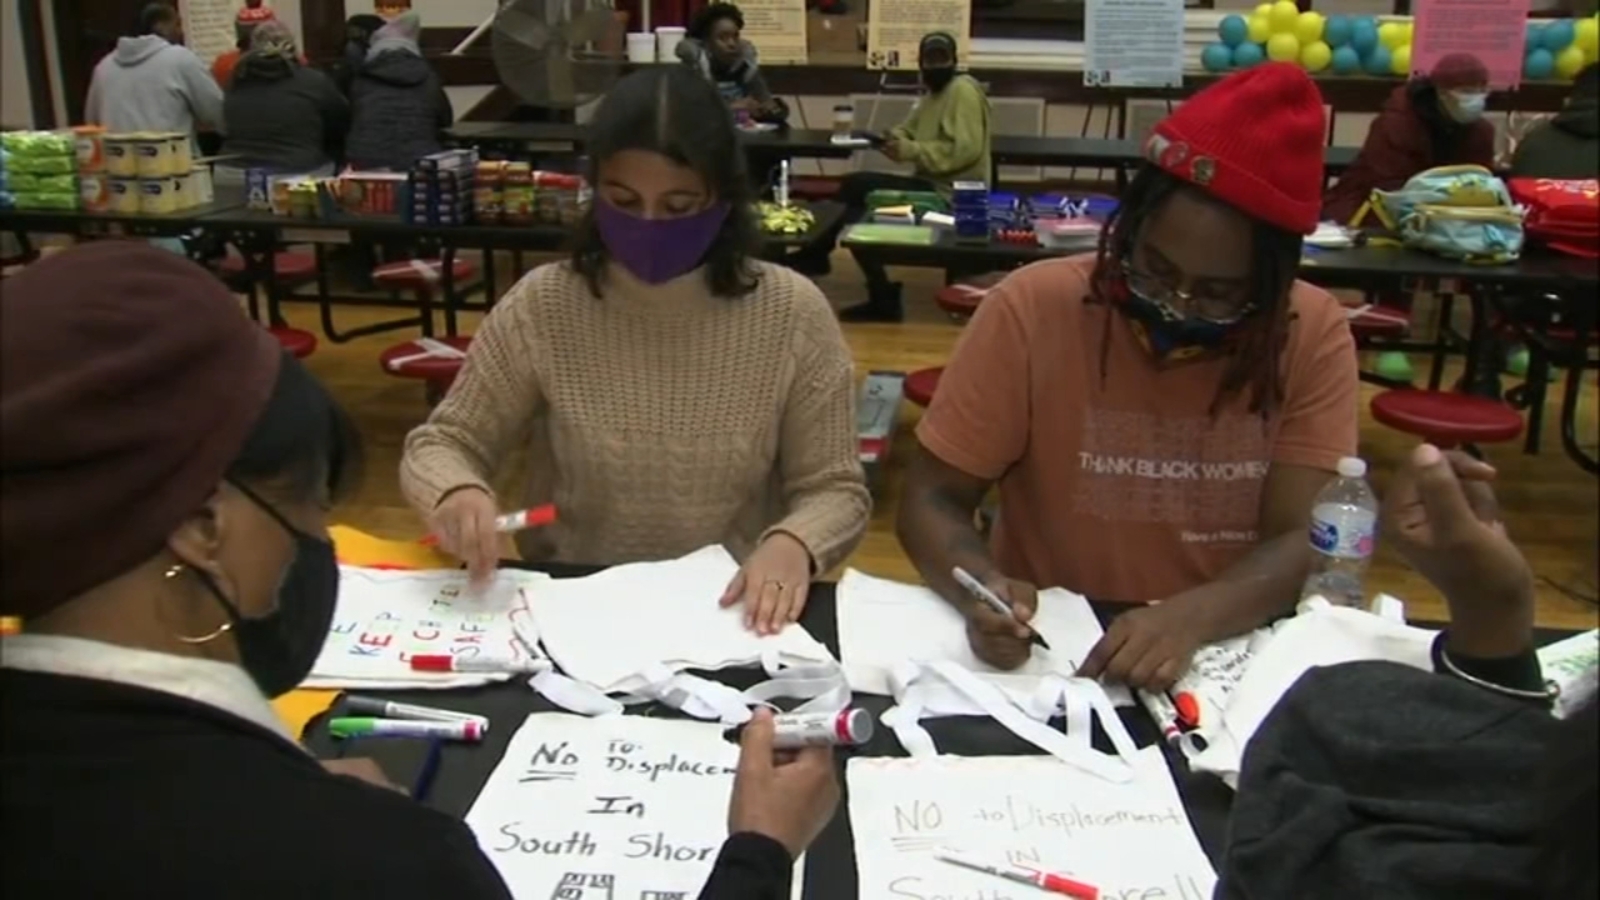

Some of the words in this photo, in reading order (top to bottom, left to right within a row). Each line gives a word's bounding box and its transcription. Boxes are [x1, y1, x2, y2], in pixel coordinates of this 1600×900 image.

[1136, 457, 1199, 481] BLACK
[530, 741, 578, 766] No
[587, 796, 645, 818] In
[893, 800, 943, 832] NO
[494, 822, 596, 856] South
